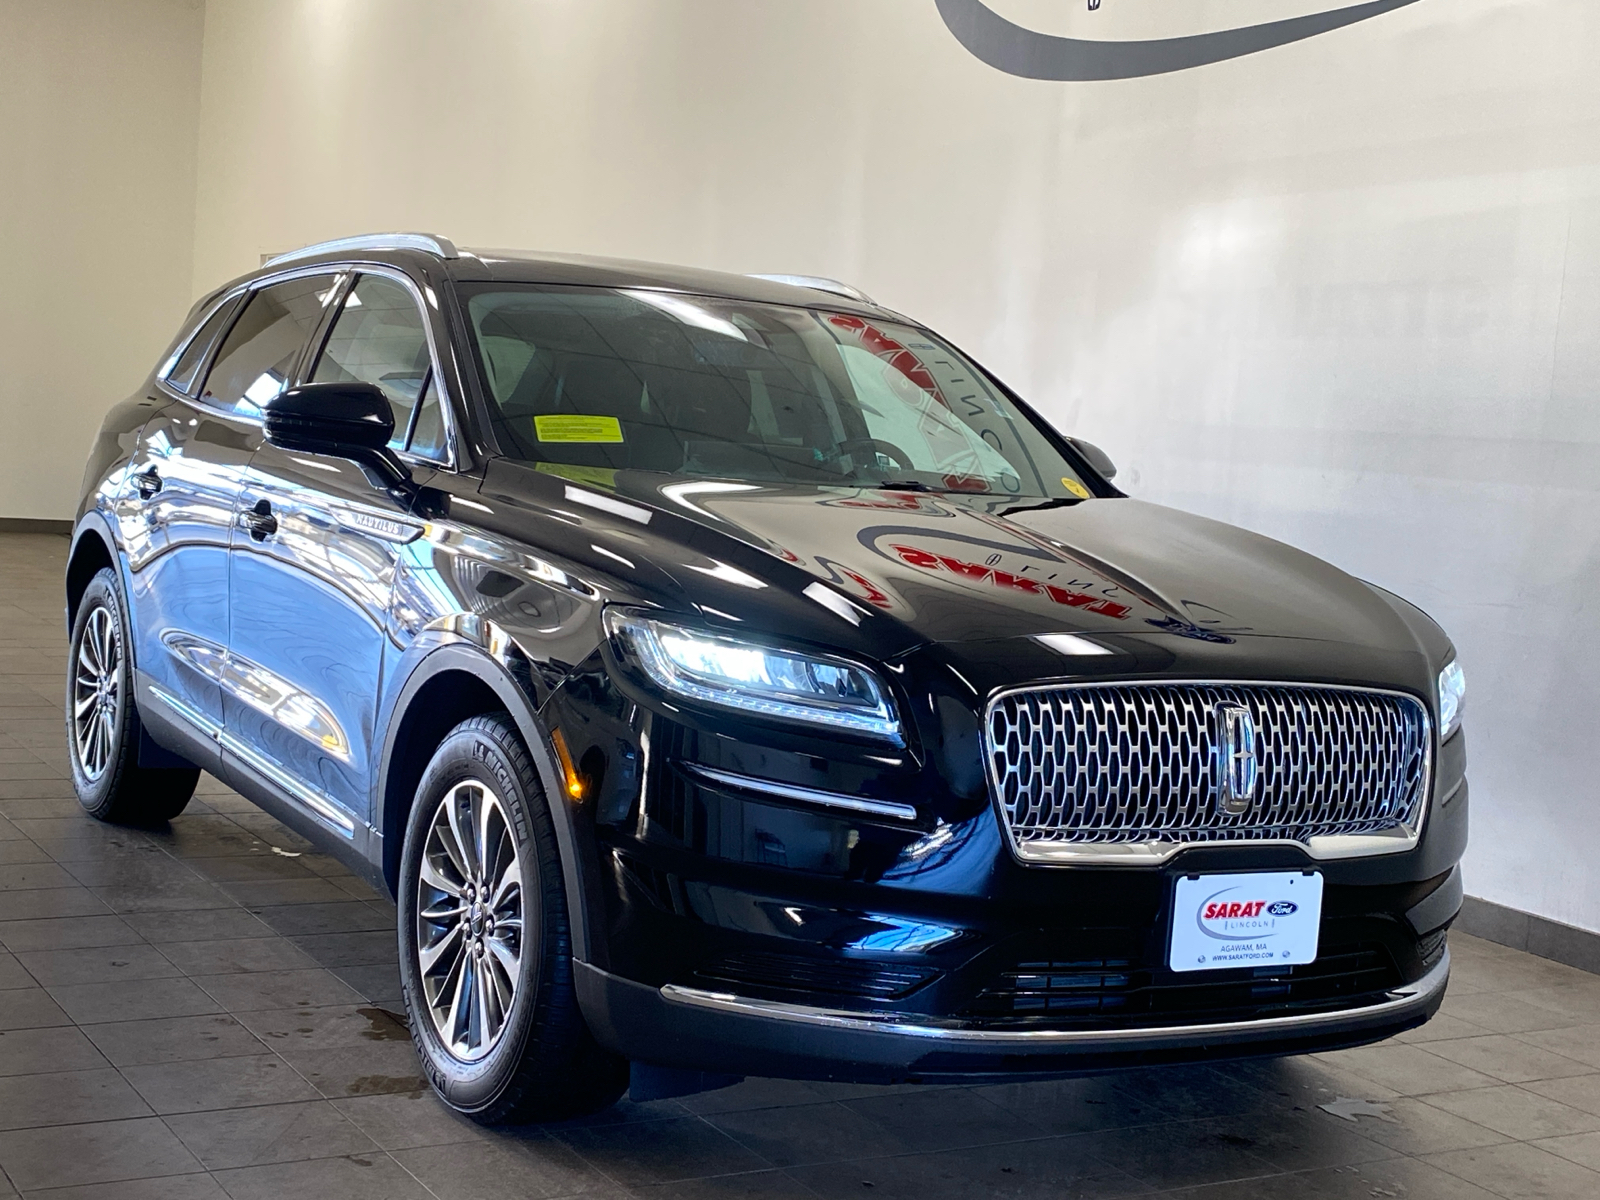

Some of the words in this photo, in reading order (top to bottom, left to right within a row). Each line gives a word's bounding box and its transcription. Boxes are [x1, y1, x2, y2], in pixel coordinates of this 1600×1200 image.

[356, 514, 400, 535] NAUTILUS
[484, 750, 528, 840] MICHELIN
[1203, 900, 1267, 920] SARAT
[1271, 903, 1293, 914] Ford
[1230, 920, 1269, 929] LINCOLN
[1220, 944, 1254, 953] AGAWAM,
[1256, 943, 1267, 951] MA
[1212, 952, 1274, 961] WWW.SARATFORD.COM
